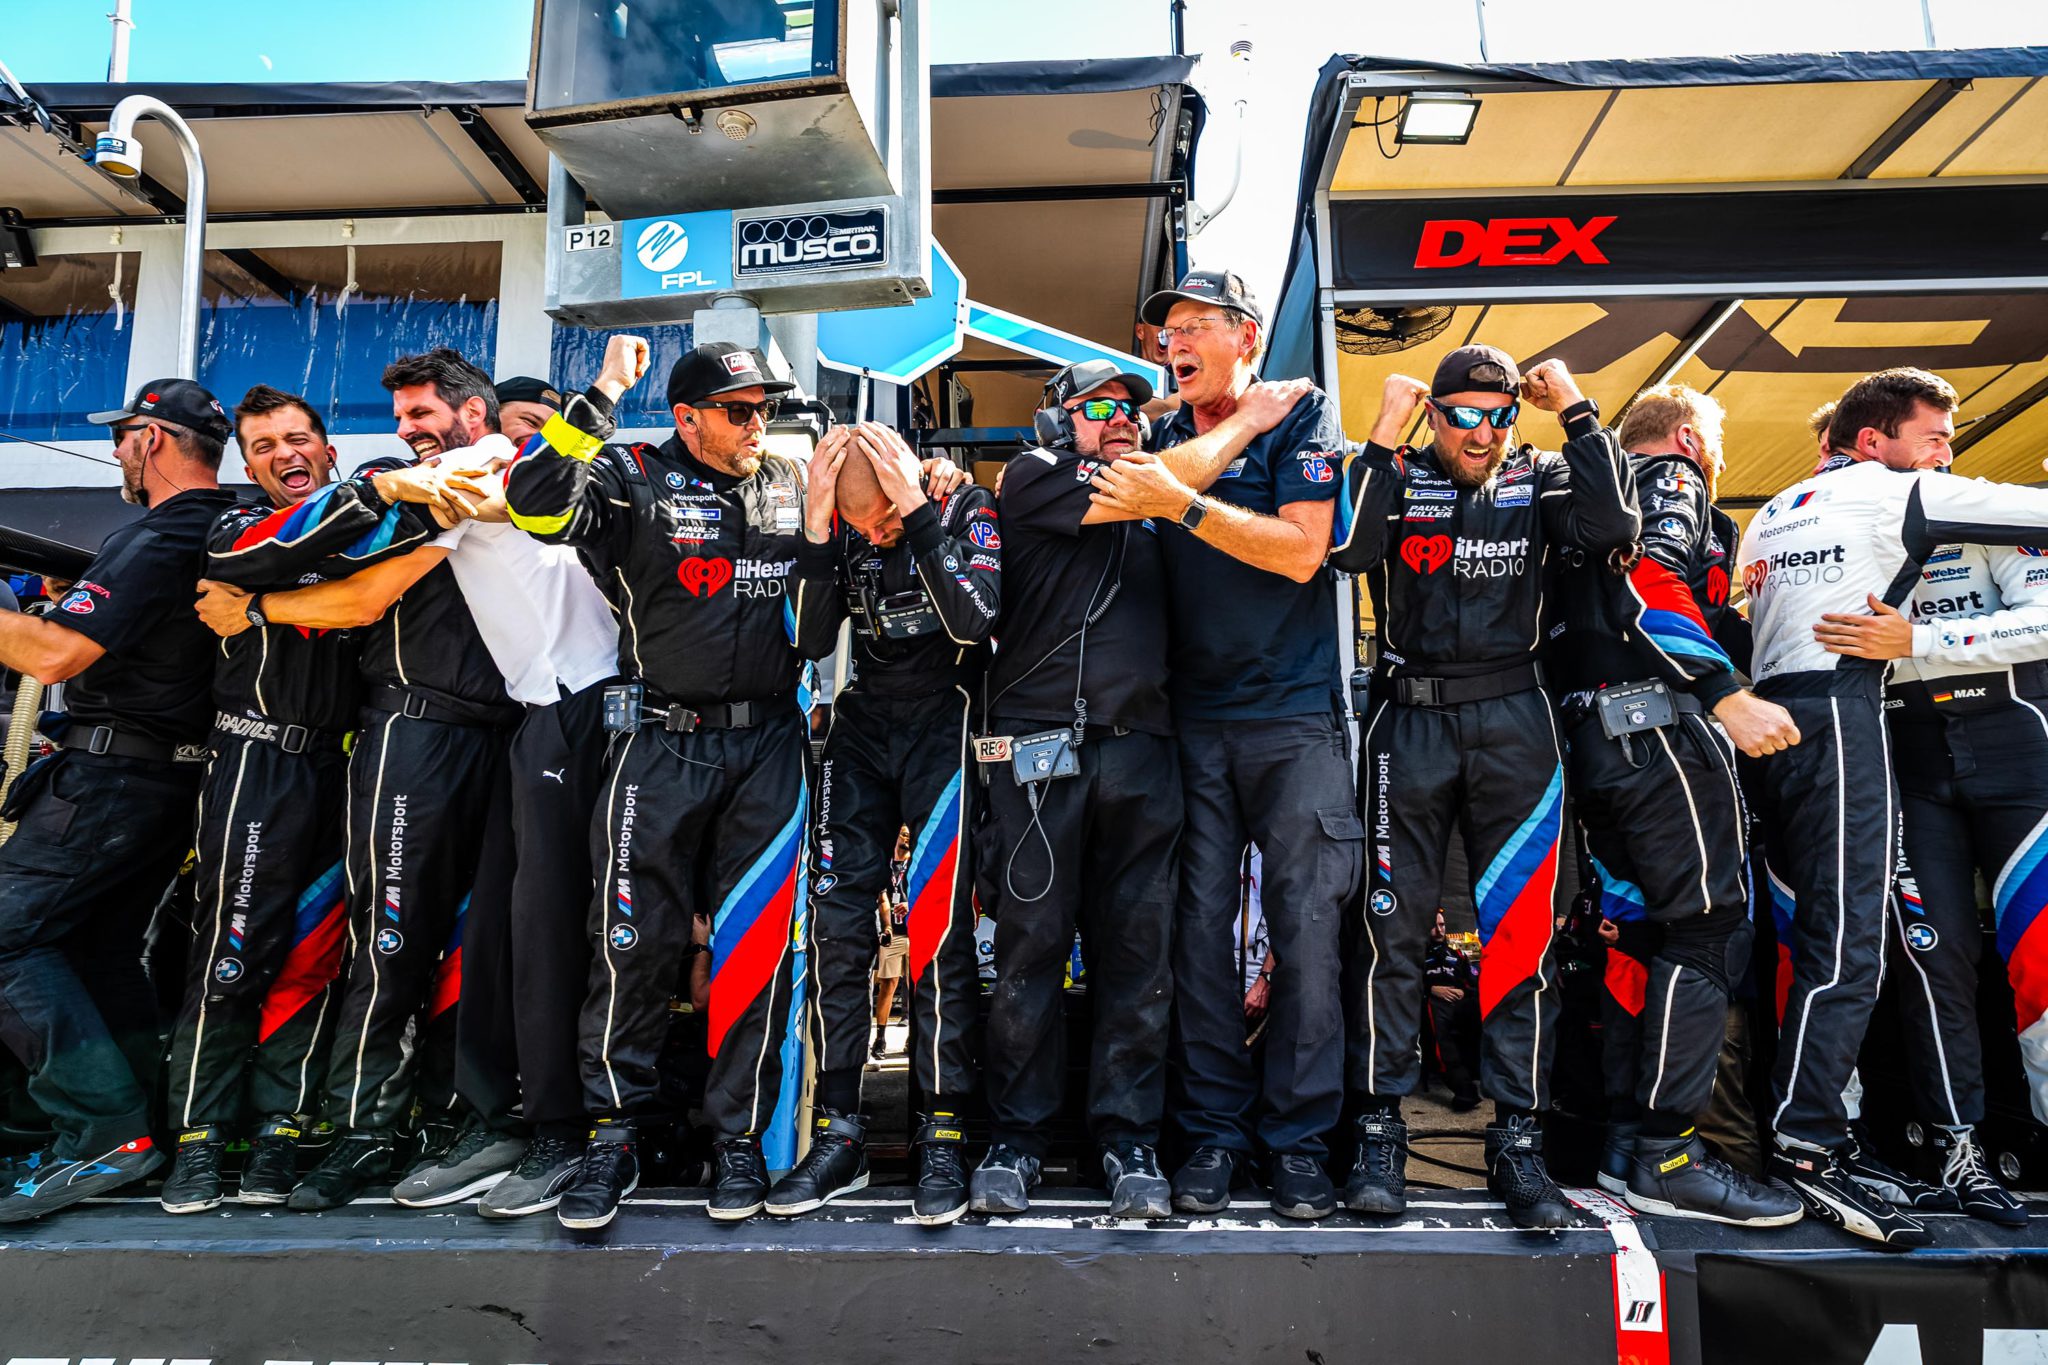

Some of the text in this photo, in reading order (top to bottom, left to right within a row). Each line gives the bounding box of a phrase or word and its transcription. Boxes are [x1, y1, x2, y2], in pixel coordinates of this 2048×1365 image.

[1413, 215, 1619, 269] DEX
[661, 271, 714, 290] FPL
[672, 492, 718, 504] Motorsport
[673, 532, 720, 540] MILLER
[677, 525, 708, 533] PAUL
[1757, 515, 1821, 542] Motorsport
[1453, 558, 1525, 580] RADIO
[1769, 544, 1846, 574] iHeart
[1767, 565, 1845, 593] RADIO
[1929, 566, 1972, 580] Weber
[1953, 687, 1987, 699] MAX
[817, 759, 834, 836] Motorsport
[1375, 752, 1391, 840] Motorsport
[385, 794, 408, 881] Motorsport
[616, 783, 639, 873] Motorsport
[233, 821, 263, 908] Motorsport
[1662, 1155, 1687, 1172] Sabelt
